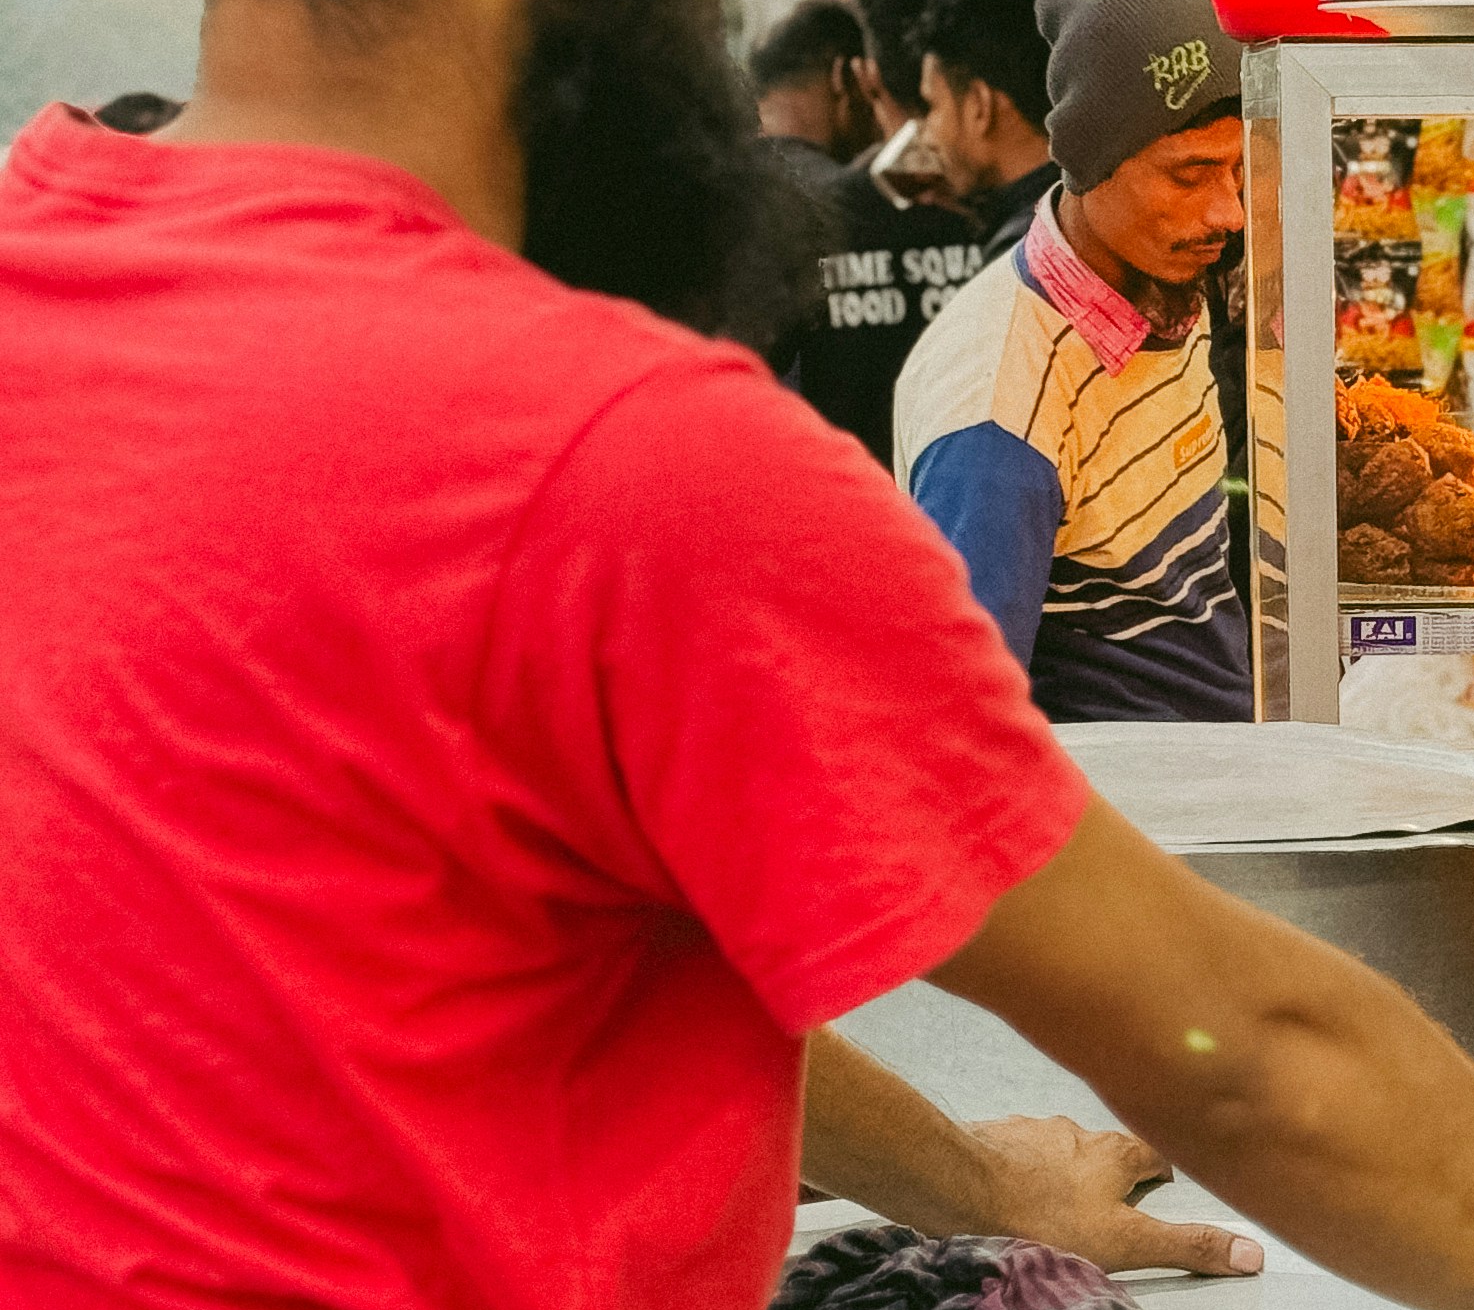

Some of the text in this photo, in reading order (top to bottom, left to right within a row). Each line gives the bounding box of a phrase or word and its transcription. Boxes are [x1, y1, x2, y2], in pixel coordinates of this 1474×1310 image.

[818, 244, 983, 290] TIME SQUA
[827, 285, 962, 329] FOOD CO
